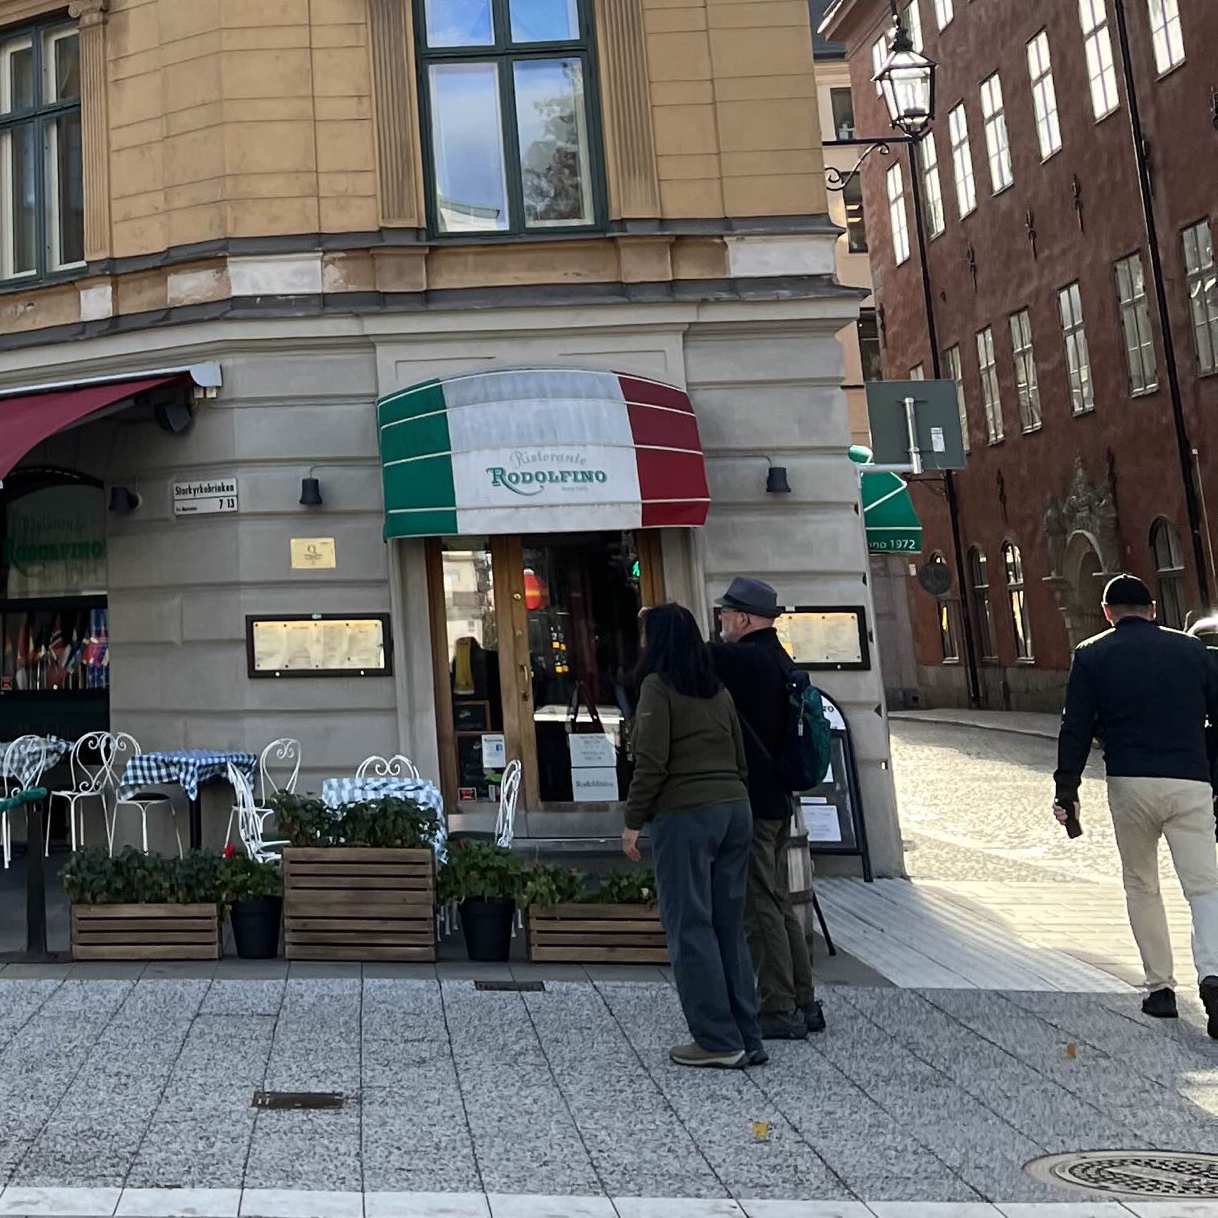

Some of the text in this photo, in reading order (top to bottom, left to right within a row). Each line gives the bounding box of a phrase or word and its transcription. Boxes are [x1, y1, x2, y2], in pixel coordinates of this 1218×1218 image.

[510, 450, 587, 469] Ristorante
[175, 481, 235, 496] Storkyrkobrinken
[486, 467, 607, 496] RODOLFINO
[227, 498, 235, 509] 13
[890, 539, 916, 549] 1972
